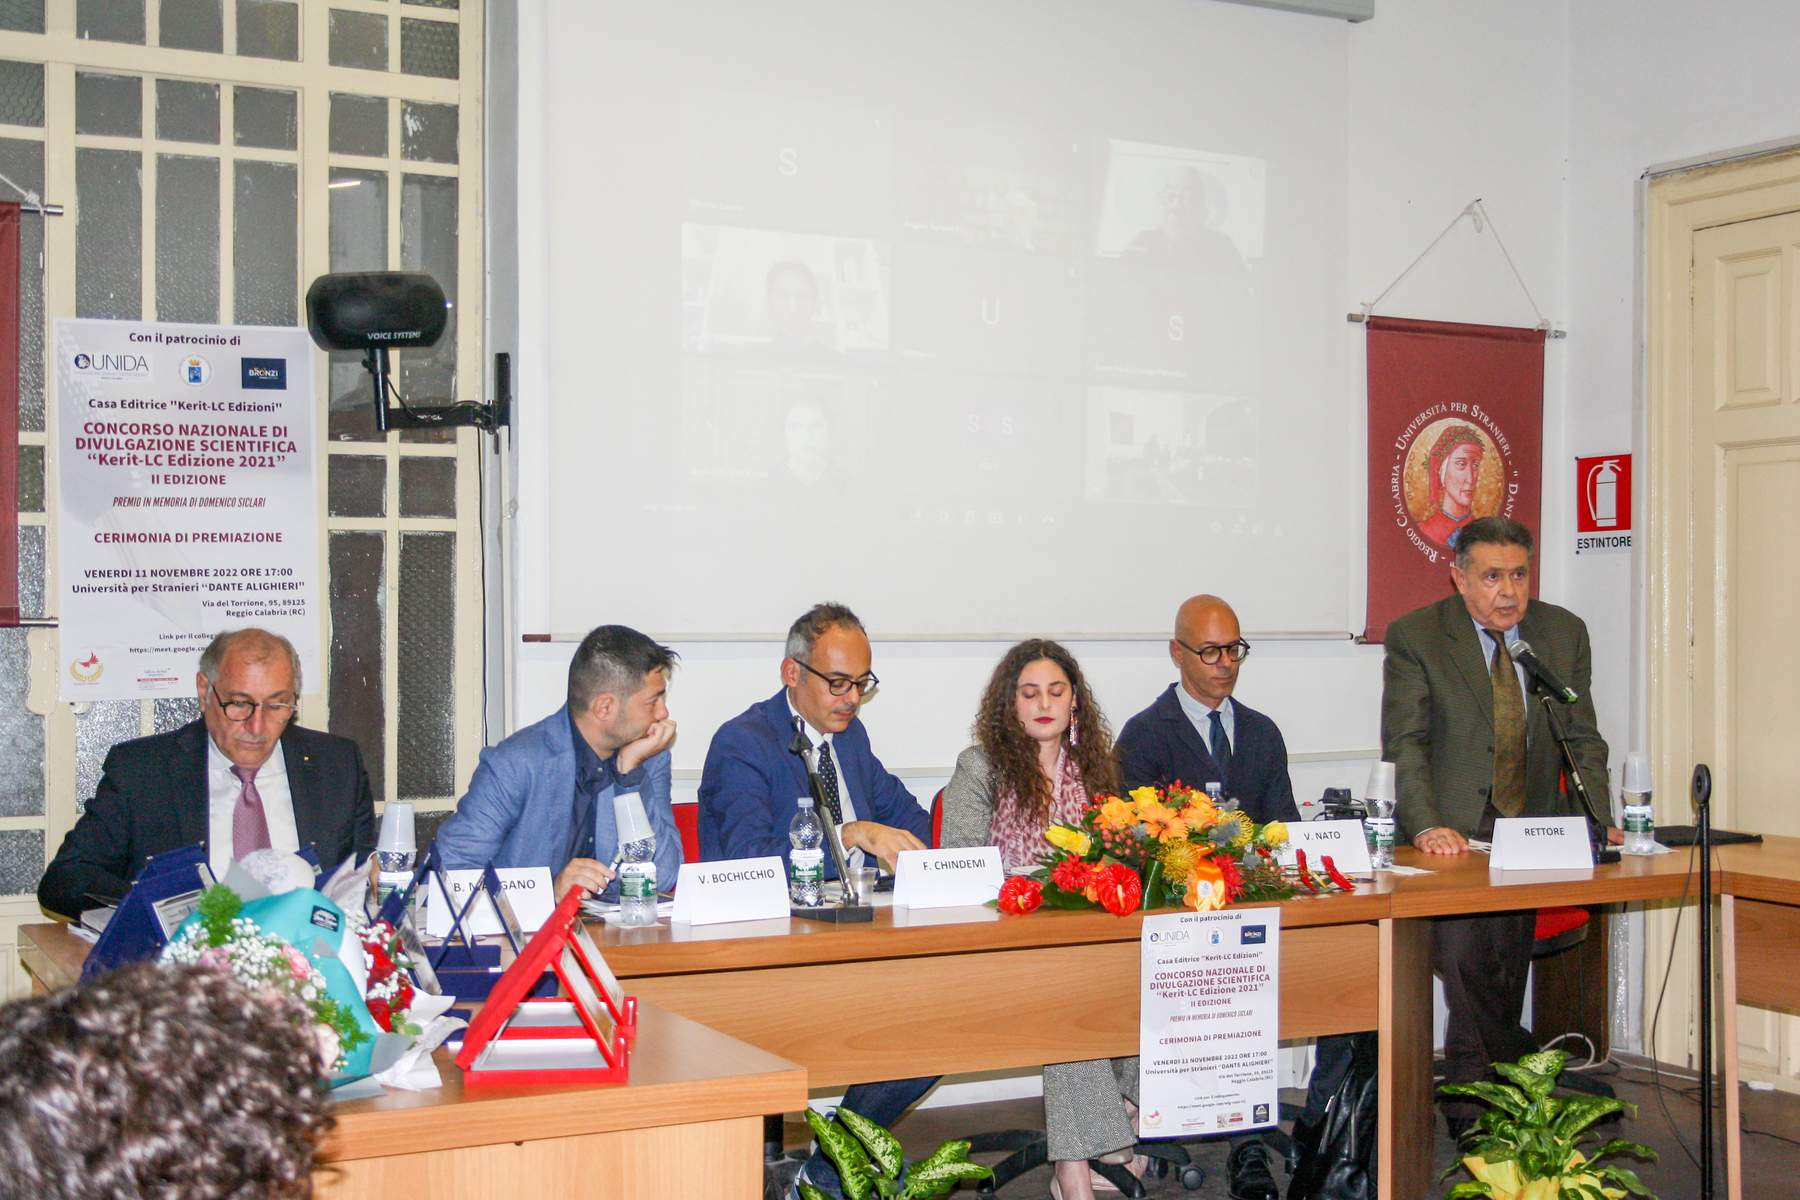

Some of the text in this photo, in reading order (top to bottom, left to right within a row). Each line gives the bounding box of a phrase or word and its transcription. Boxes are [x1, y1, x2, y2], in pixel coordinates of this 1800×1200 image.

[129, 333, 241, 346] Con il patrocinio di
[367, 331, 421, 340] VOICE SYSTEMS
[249, 369, 278, 377] BRONZI
[89, 399, 282, 412] Casa Editrice "Kerit-LC Edizioni"
[83, 422, 288, 437] CONCORSO NAZIONALE DI
[1451, 402, 1468, 413] PER
[1471, 404, 1512, 457] STRANIERI
[75, 438, 297, 453] DIVULGAZIONE SCIENTIFICA
[87, 453, 285, 468] “Kerit-LC Edizione 2021”
[151, 474, 226, 485] II EDIZIONE
[1391, 465, 1407, 527] CALABRIA
[1503, 482, 1518, 519] DANT
[113, 497, 266, 508] PREMIO IN MEMORIA DI DOMENICO SICLARI
[94, 532, 282, 544] CERIMONIA DI PREMIAZIONE
[1577, 536, 1631, 549] ESTINTORE
[1406, 528, 1438, 563] REGGIO
[84, 568, 293, 578] VENERDI 11 NOVEMBRE 2022 ORE 17:00
[72, 582, 305, 595] Università per Stranieri “DANTE ALIGHIERI"
[231, 600, 267, 608] Torrione,
[226, 608, 306, 618] Reggio Calabria (RC)
[1304, 831, 1341, 841] V. NATO
[1524, 827, 1565, 836] RETTORE
[923, 858, 986, 871] F. CHINDEMI
[698, 868, 775, 884] V. BOCHICCHIO
[454, 883, 465, 892] B.
[1200, 914, 1233, 923] patrocinio
[1155, 965, 1265, 981] CONCORSO NAZIONALE DI
[1150, 974, 1270, 990] DIVULGAZIONE SCIENTIFICA
[1200, 985, 1236, 996] Edizione
[1197, 998, 1231, 1007] EDIZIONE
[1192, 1012, 1211, 1021] MEMORIA
[1217, 1010, 1237, 1019] DOMENICO
[1238, 1009, 1253, 1017] SICLARI
[1159, 1035, 1202, 1045] CERIMONIA
[1213, 1030, 1262, 1040] PREMIAZIONE
[1190, 1055, 1222, 1063] NOVEMBRE
[1145, 1067, 1178, 1075] Università
